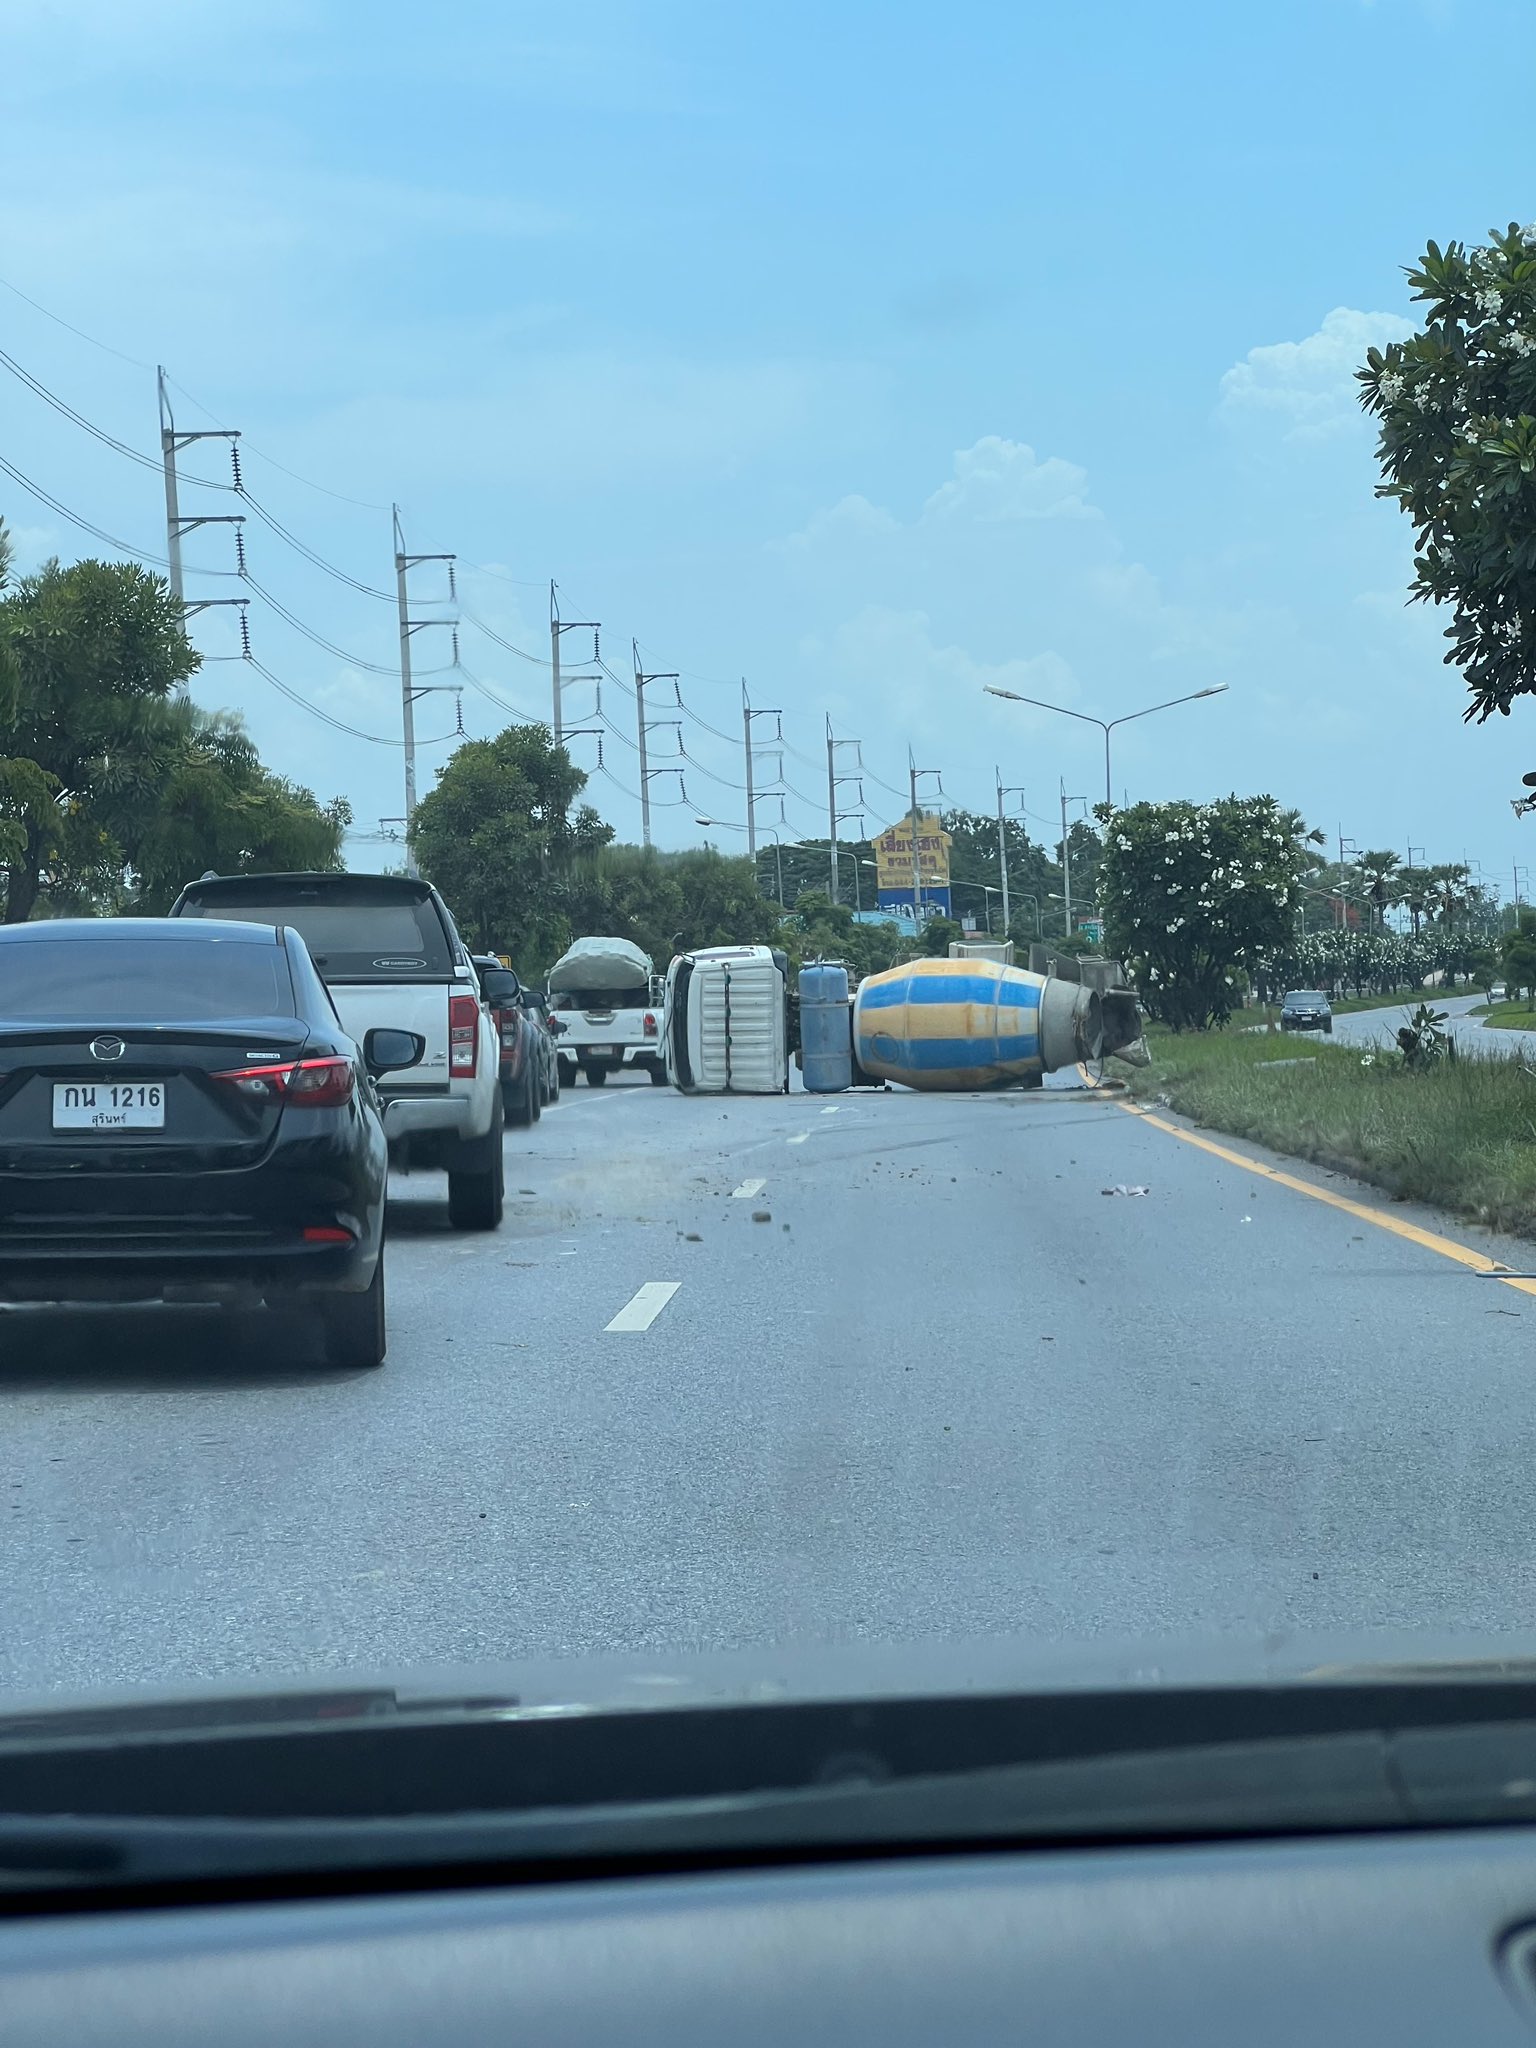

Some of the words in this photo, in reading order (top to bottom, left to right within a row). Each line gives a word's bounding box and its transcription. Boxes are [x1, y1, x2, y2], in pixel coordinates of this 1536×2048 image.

[65, 1086, 96, 1107] กน
[110, 1086, 161, 1107] 1216
[91, 1112, 127, 1127] สุรินทร์
